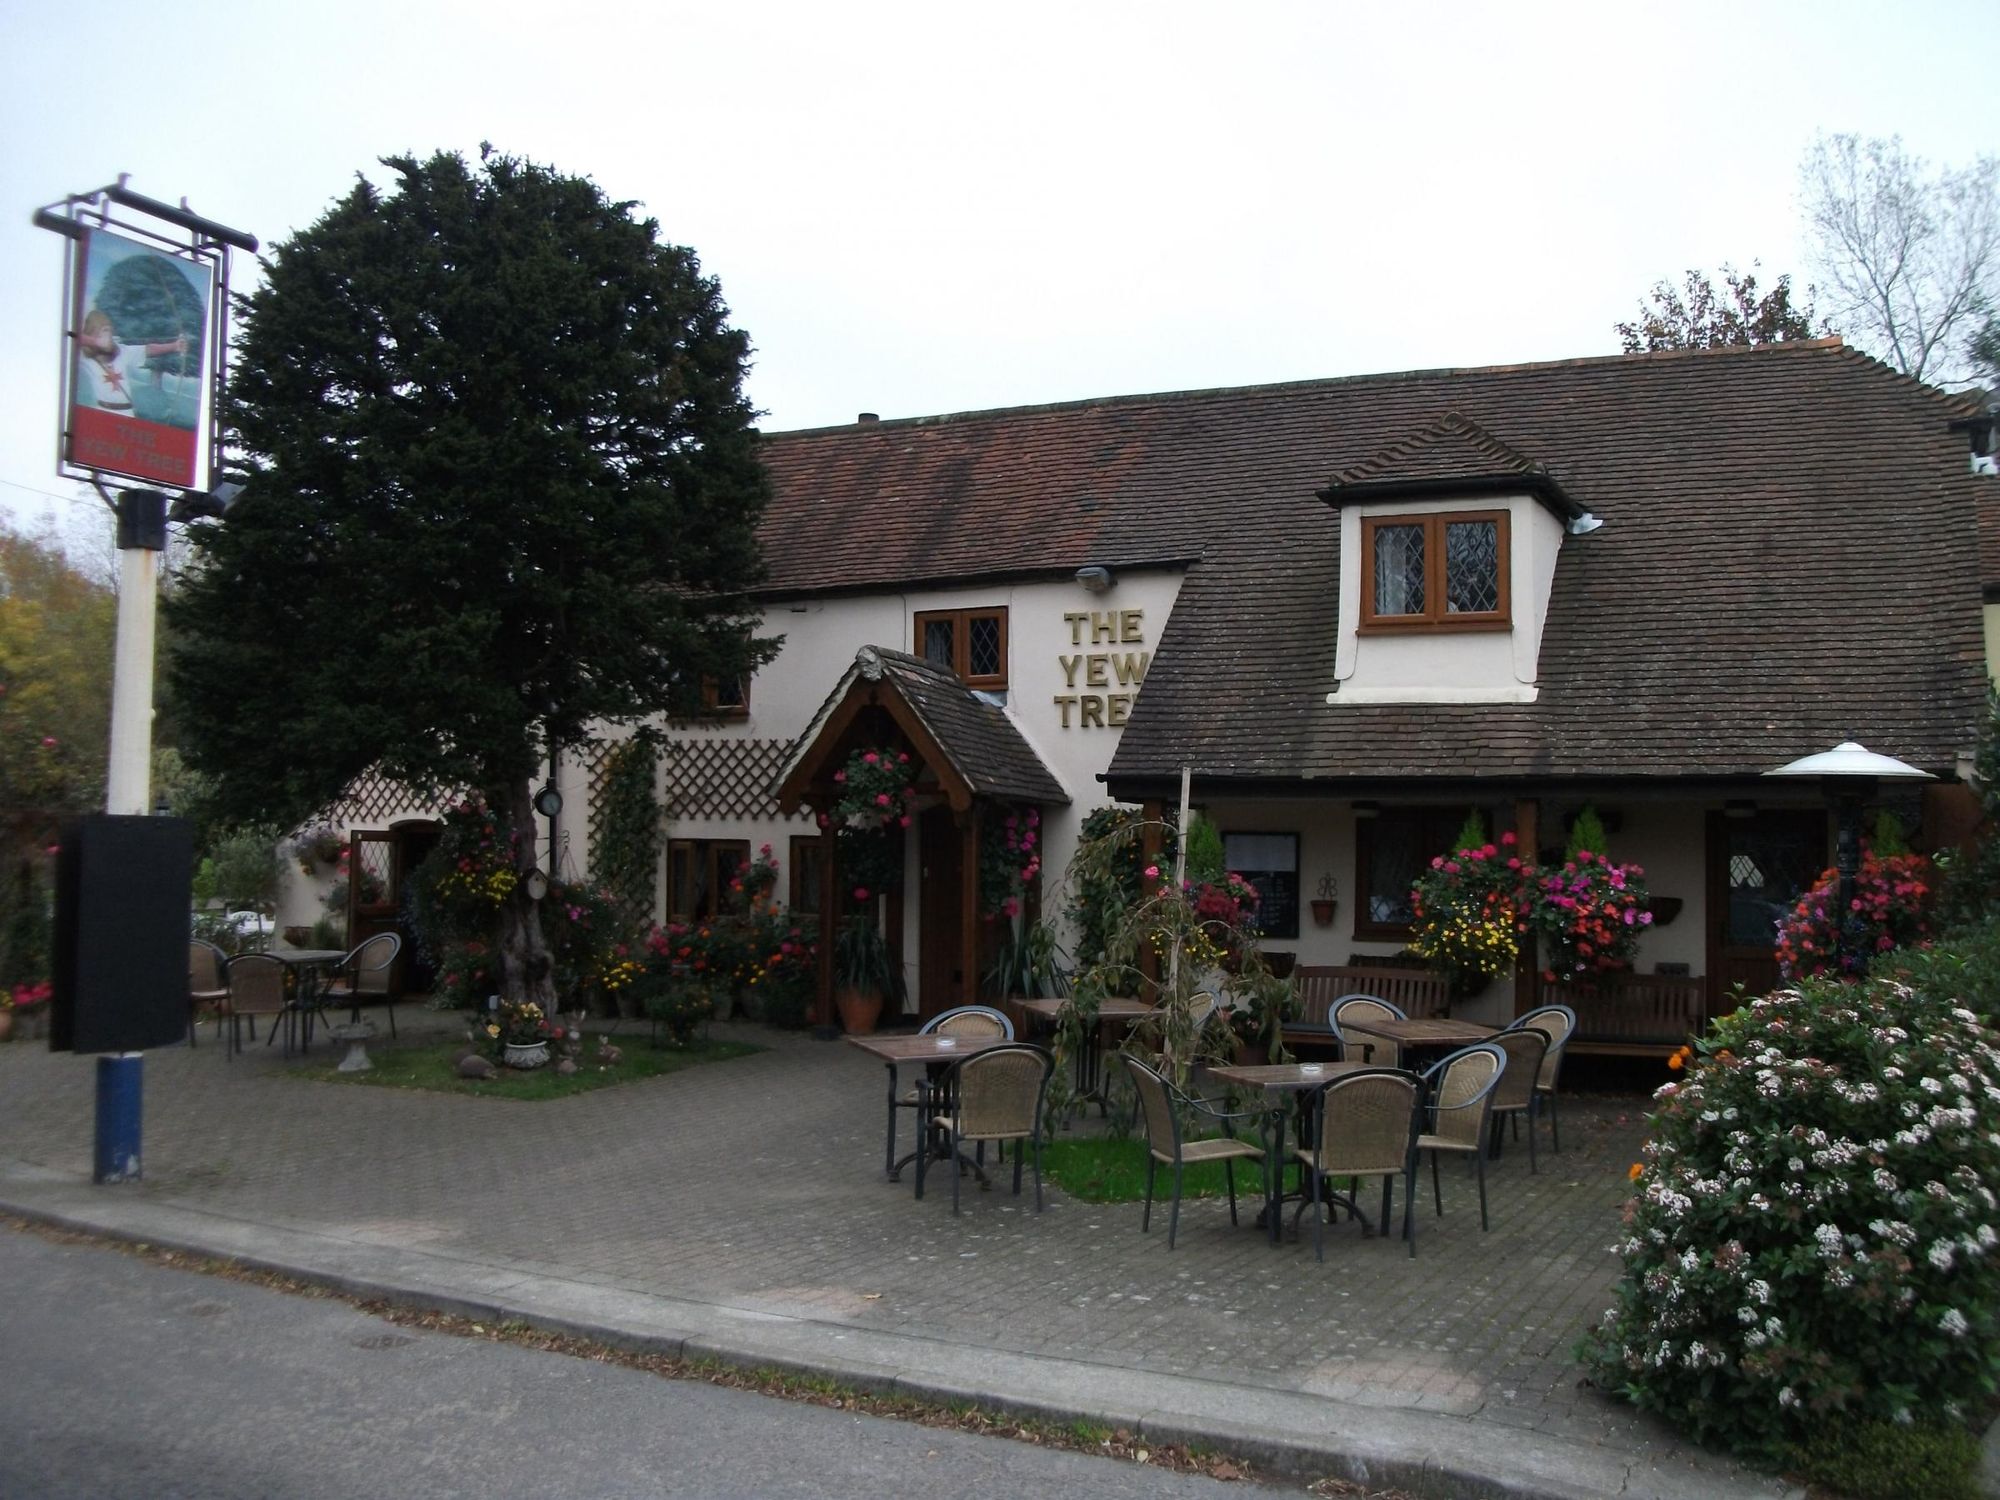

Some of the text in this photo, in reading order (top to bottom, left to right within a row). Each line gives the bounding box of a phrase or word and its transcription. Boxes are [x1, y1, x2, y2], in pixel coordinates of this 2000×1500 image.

[116, 424, 158, 448] THE
[135, 448, 188, 475] TREE
[1064, 609, 1144, 645] THE
[1058, 652, 1149, 687] YEW
[1053, 693, 1138, 728] TRE
